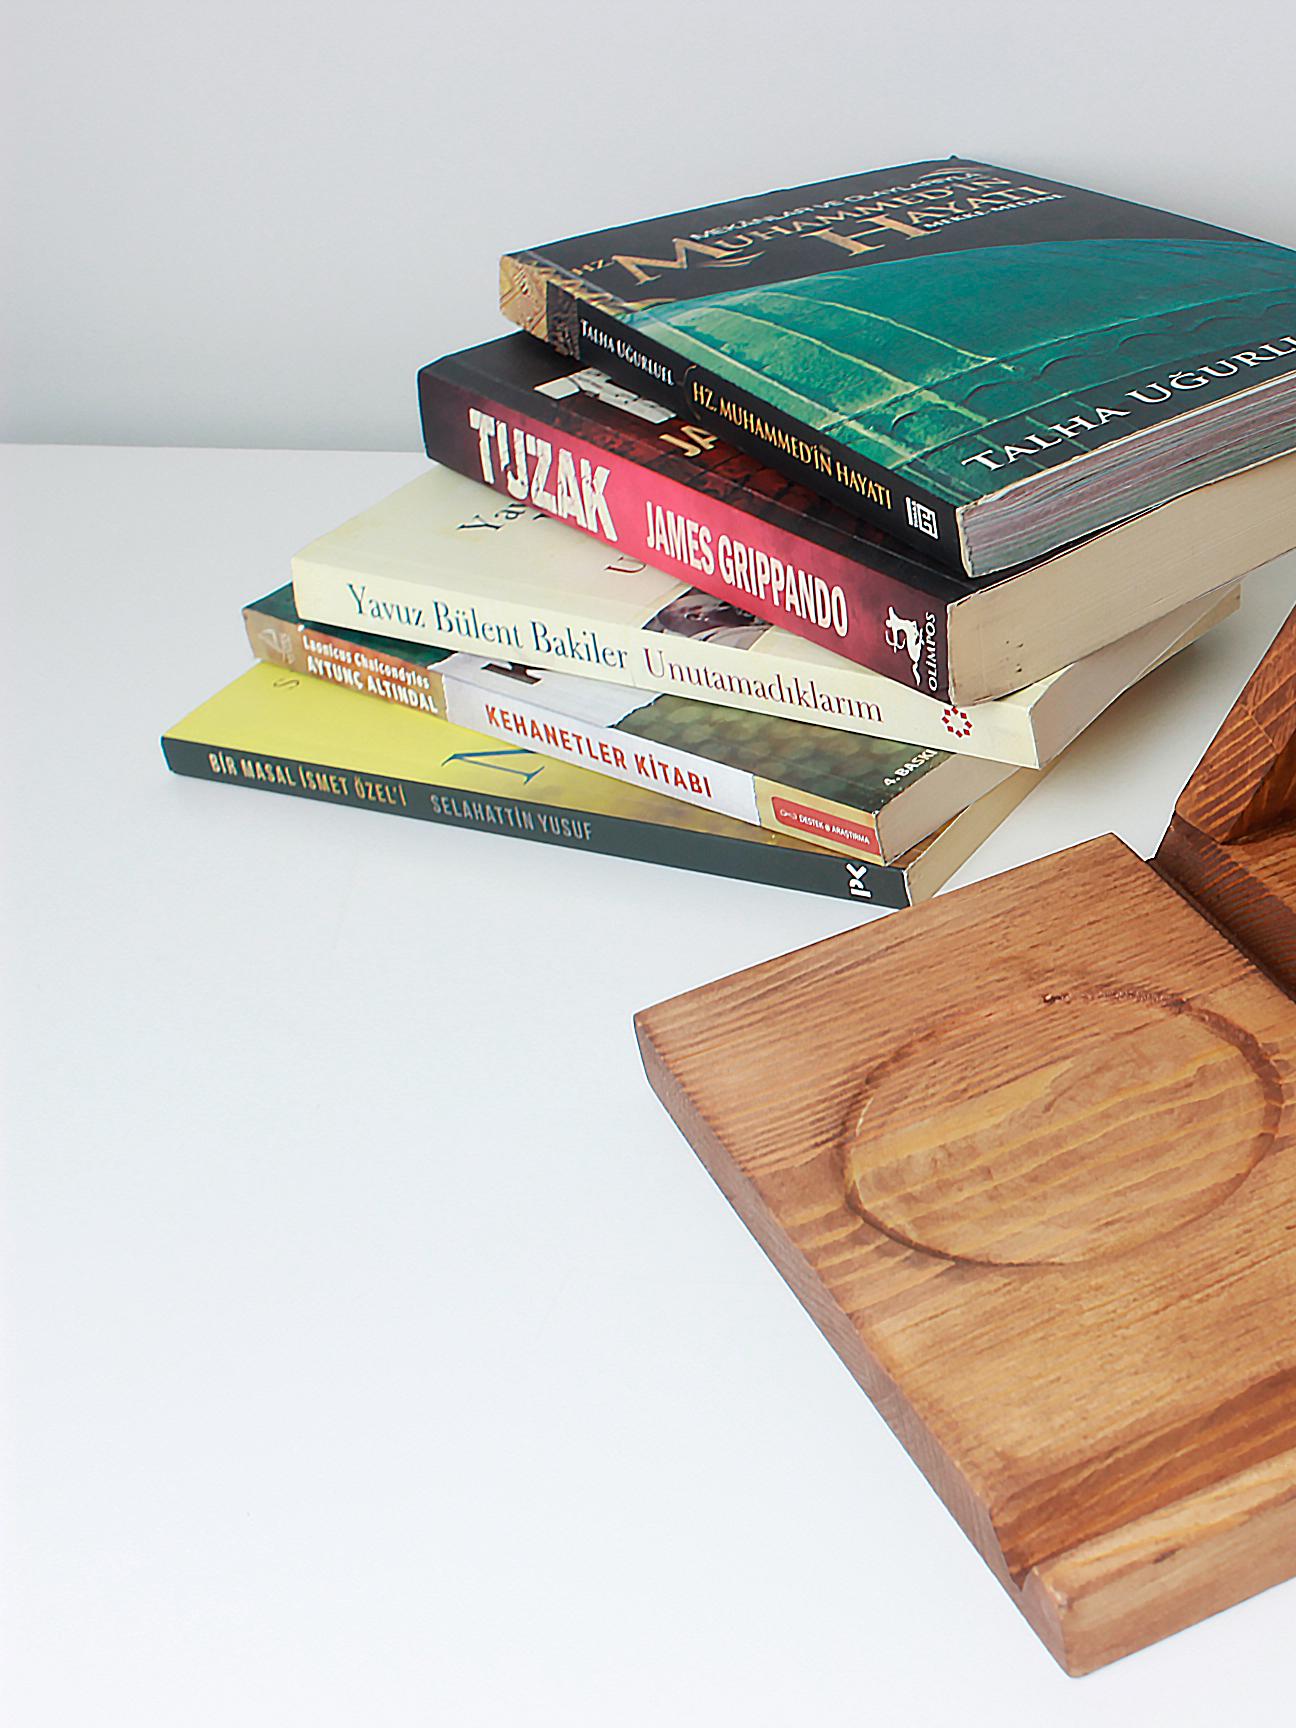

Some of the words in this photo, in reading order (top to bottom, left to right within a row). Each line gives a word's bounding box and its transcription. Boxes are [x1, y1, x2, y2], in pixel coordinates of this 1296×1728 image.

[800, 185, 1051, 257] HAYATI
[580, 318, 614, 353] TALHA
[961, 405, 1131, 473] TALHA
[468, 407, 618, 542] TUZAK
[835, 461, 893, 510] HAYATI
[646, 500, 715, 576] JAMES
[717, 534, 848, 637] GRIPPANDO
[348, 583, 425, 628] Yavuz
[433, 600, 524, 649] Bülent
[531, 620, 629, 669] Bakiler
[367, 675, 438, 714] ALTINDAL
[642, 647, 885, 723] Unutamadıklarım
[209, 751, 237, 777] BİR
[240, 758, 297, 787] MASAL
[299, 766, 349, 796] İSMET
[485, 703, 627, 770] KEHANETLER
[634, 753, 713, 798] KİTABI
[894, 748, 938, 778] BASKI
[430, 794, 534, 831] SELAHATTİN
[537, 813, 592, 841] YUSUF
